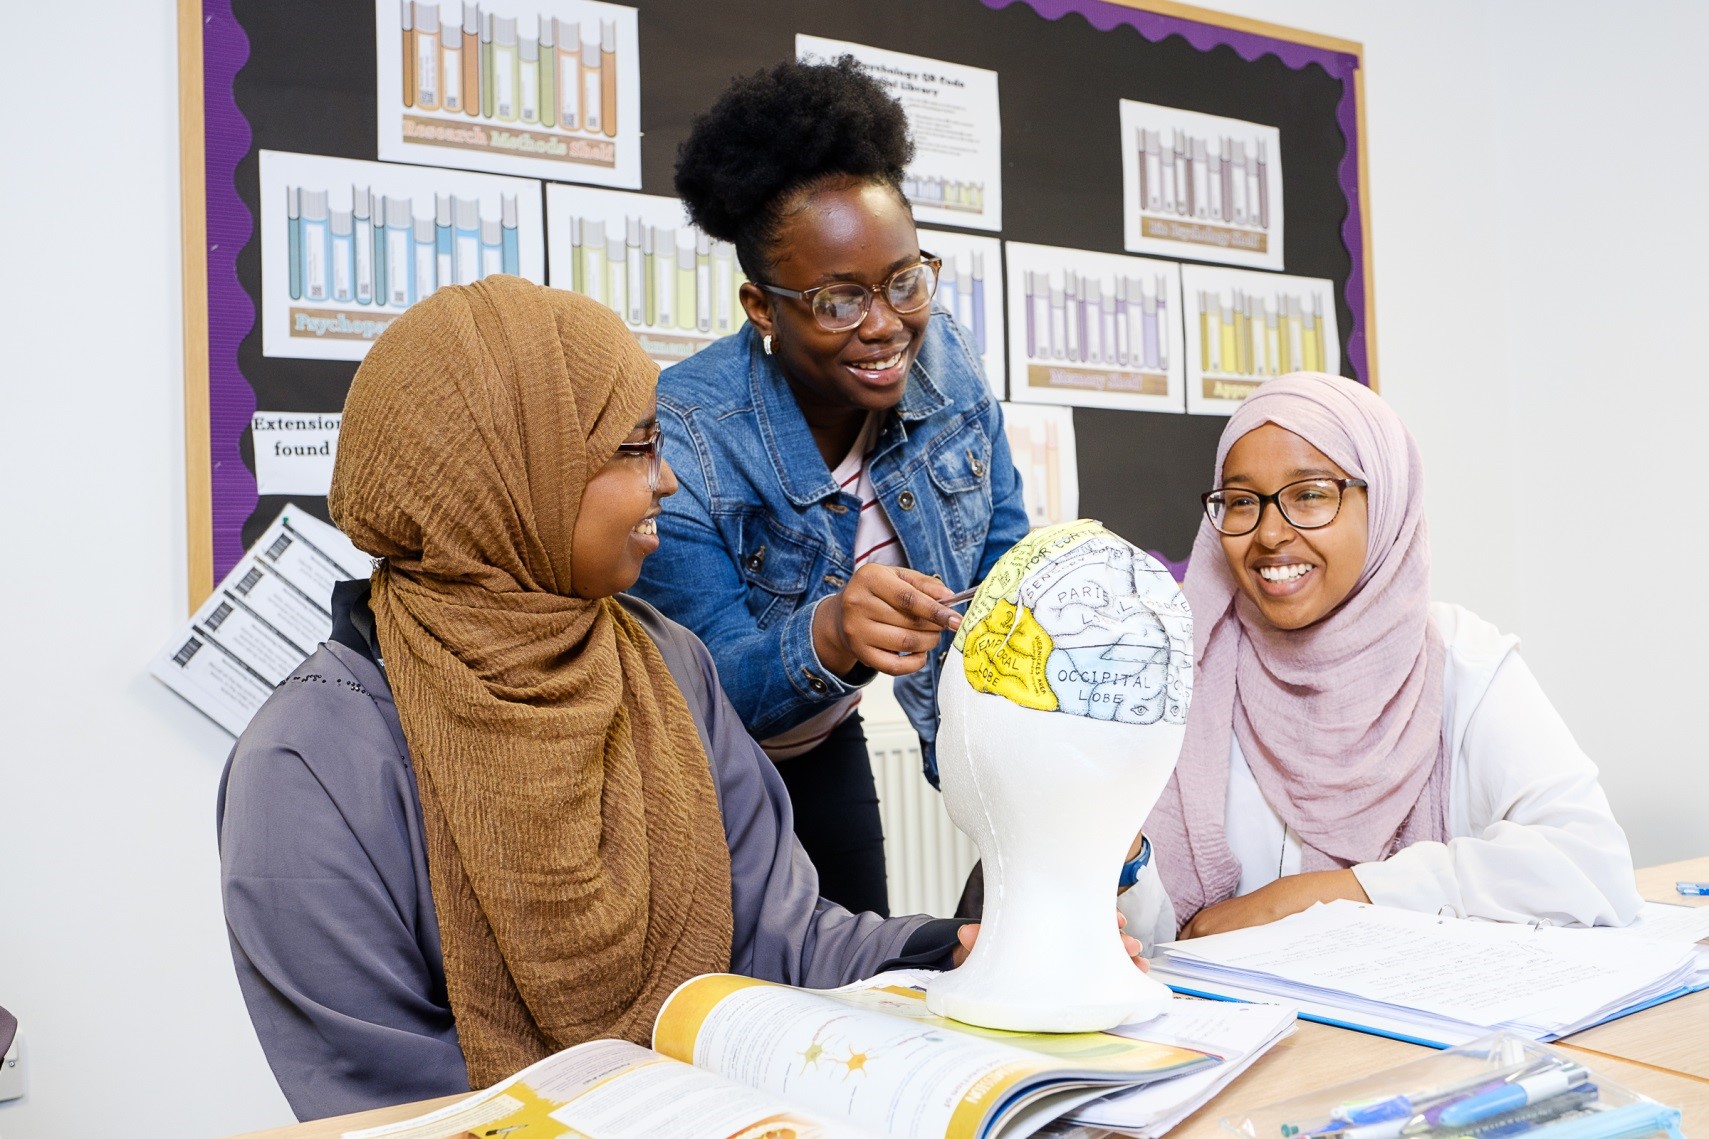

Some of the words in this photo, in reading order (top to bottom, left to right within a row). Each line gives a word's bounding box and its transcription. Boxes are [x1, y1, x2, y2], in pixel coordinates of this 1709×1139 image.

[274, 441, 330, 457] found
[978, 662, 1000, 687] LOBE
[1058, 669, 1151, 689] OCCIPITAL
[1078, 689, 1124, 704] LOBE
